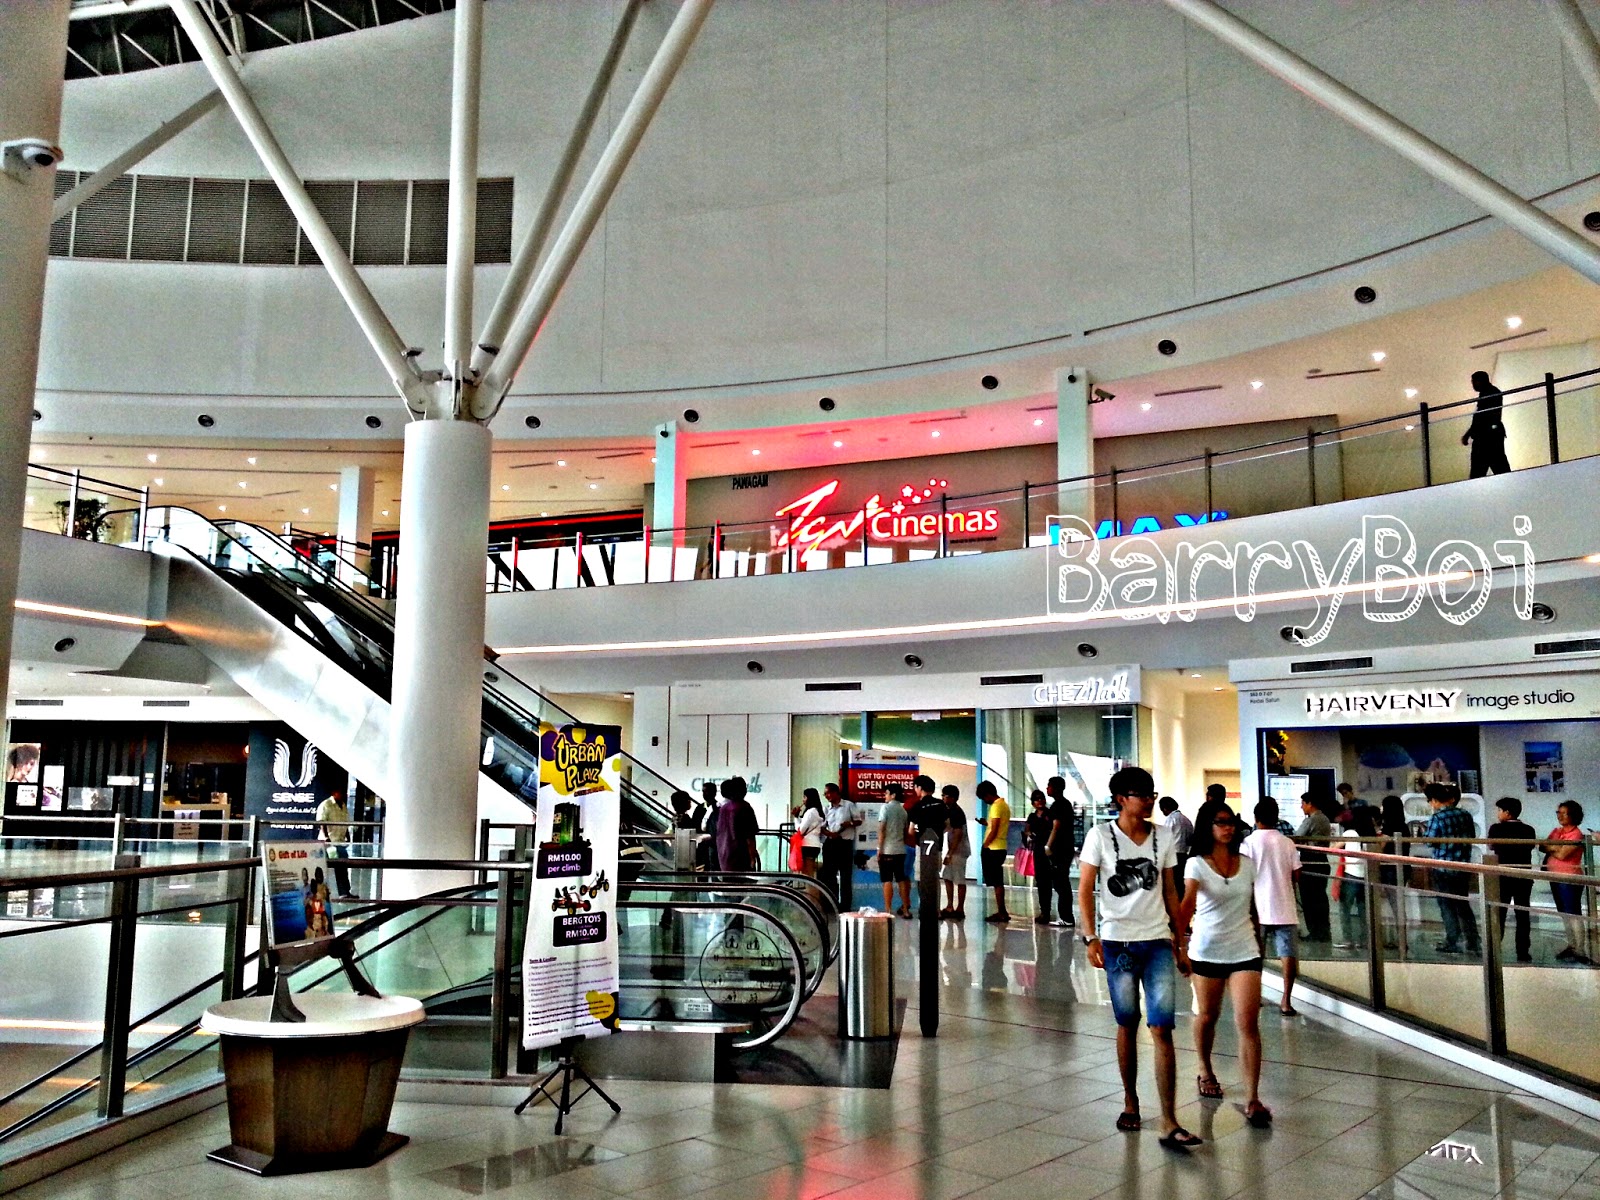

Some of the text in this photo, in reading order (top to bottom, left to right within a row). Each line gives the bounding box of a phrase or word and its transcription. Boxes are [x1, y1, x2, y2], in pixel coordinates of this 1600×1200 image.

[732, 474, 769, 490] PAWAGAM
[870, 508, 999, 538] Cinemas
[1306, 689, 1576, 714] HAIRVENLY image studio
[556, 735, 606, 770] URBAN
[566, 765, 601, 791] PLAYZ
[857, 780, 882, 790] OPEN
[278, 850, 308, 859] Gift of Life
[923, 840, 935, 856] 7
[547, 853, 582, 862] RM10.00
[547, 864, 582, 874] per climb
[562, 914, 602, 926] BERG TOYS
[565, 927, 599, 939] RM10.00
